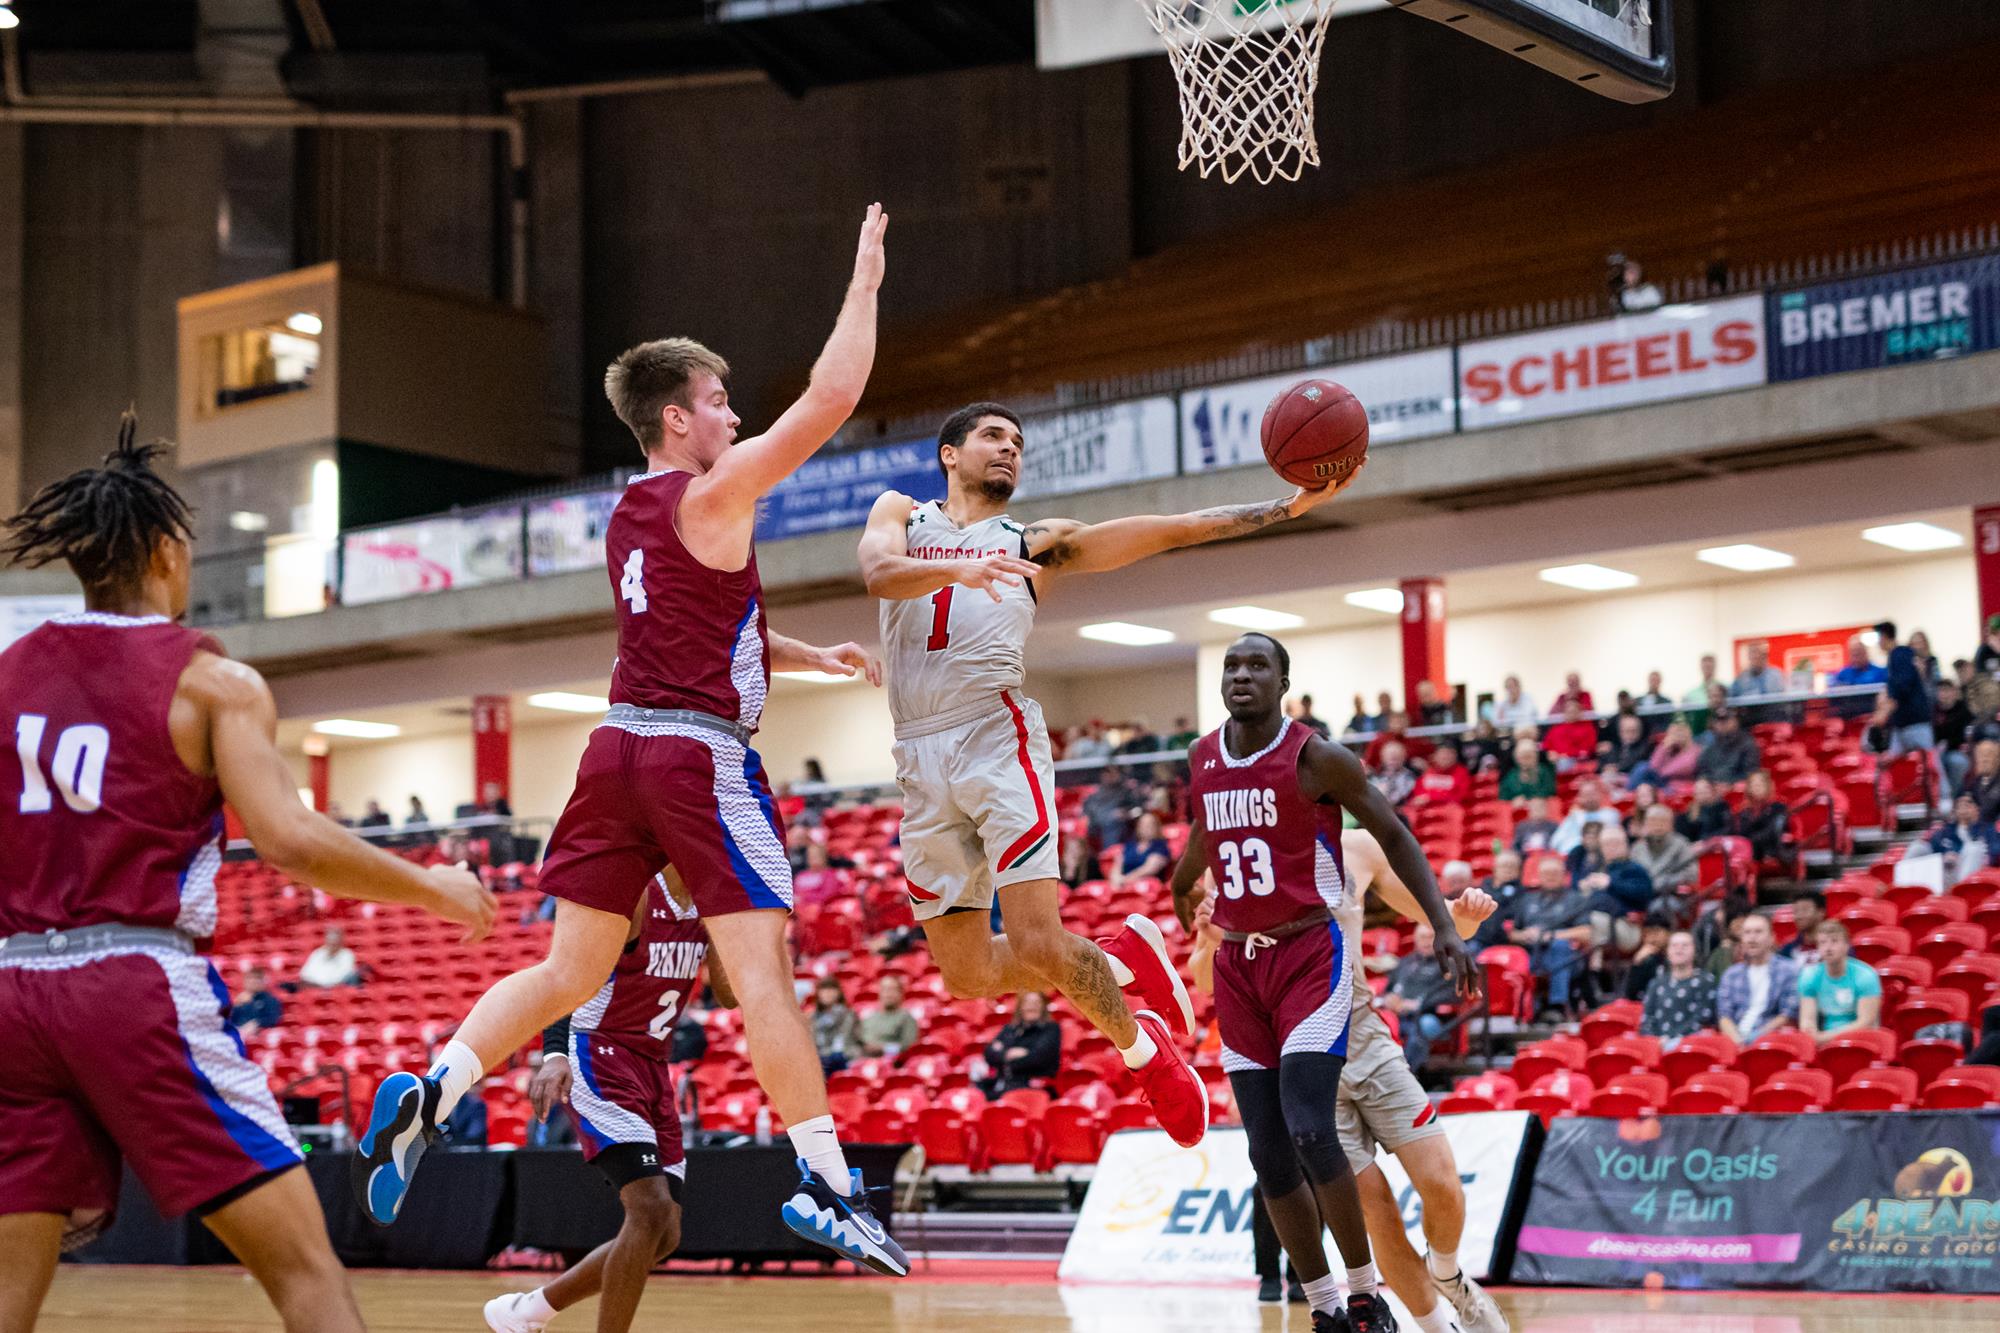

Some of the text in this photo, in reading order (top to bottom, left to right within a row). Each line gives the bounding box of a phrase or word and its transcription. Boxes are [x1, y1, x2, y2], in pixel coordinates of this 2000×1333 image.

[1781, 282, 1969, 347] BREMER
[1887, 318, 1970, 356] BANK
[1464, 321, 1758, 404] SCHEELS
[1313, 455, 1360, 478] Wil
[619, 548, 648, 614] 4
[927, 585, 955, 653] 1
[15, 713, 111, 815] 10
[1202, 787, 1278, 832] VIKINGS
[1217, 837, 1277, 900] 33
[645, 989, 681, 1041] 2
[1594, 1145, 1778, 1182] Your Oasis
[1631, 1188, 1734, 1223] 4 Fun
[1587, 1236, 1753, 1258] 4bearscasino.com
[1828, 1239, 1909, 1256] CASINO
[1943, 1240, 2000, 1256] LODG
